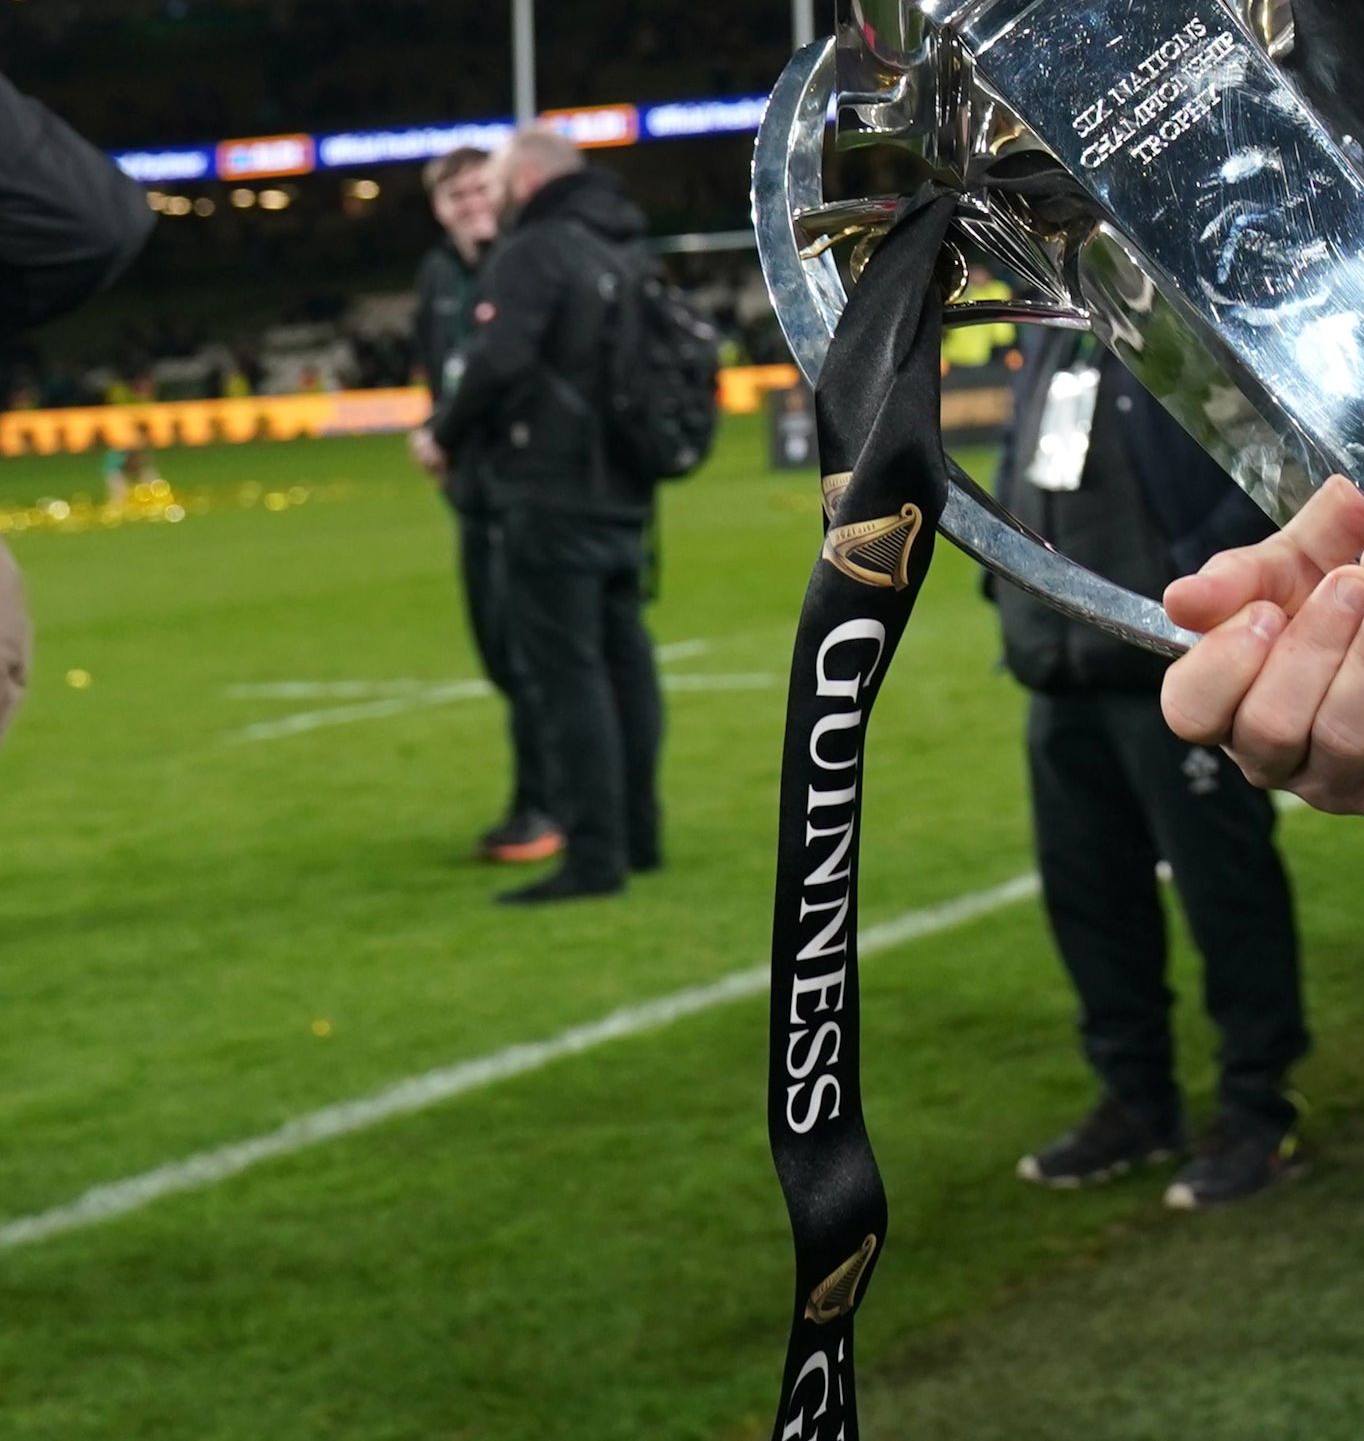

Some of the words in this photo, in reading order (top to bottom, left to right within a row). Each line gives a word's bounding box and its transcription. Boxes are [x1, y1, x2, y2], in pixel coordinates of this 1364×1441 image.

[1072, 96, 1113, 139] SIX
[1108, 17, 1208, 106] NATIONS
[785, 617, 887, 1135] GUINNESS
